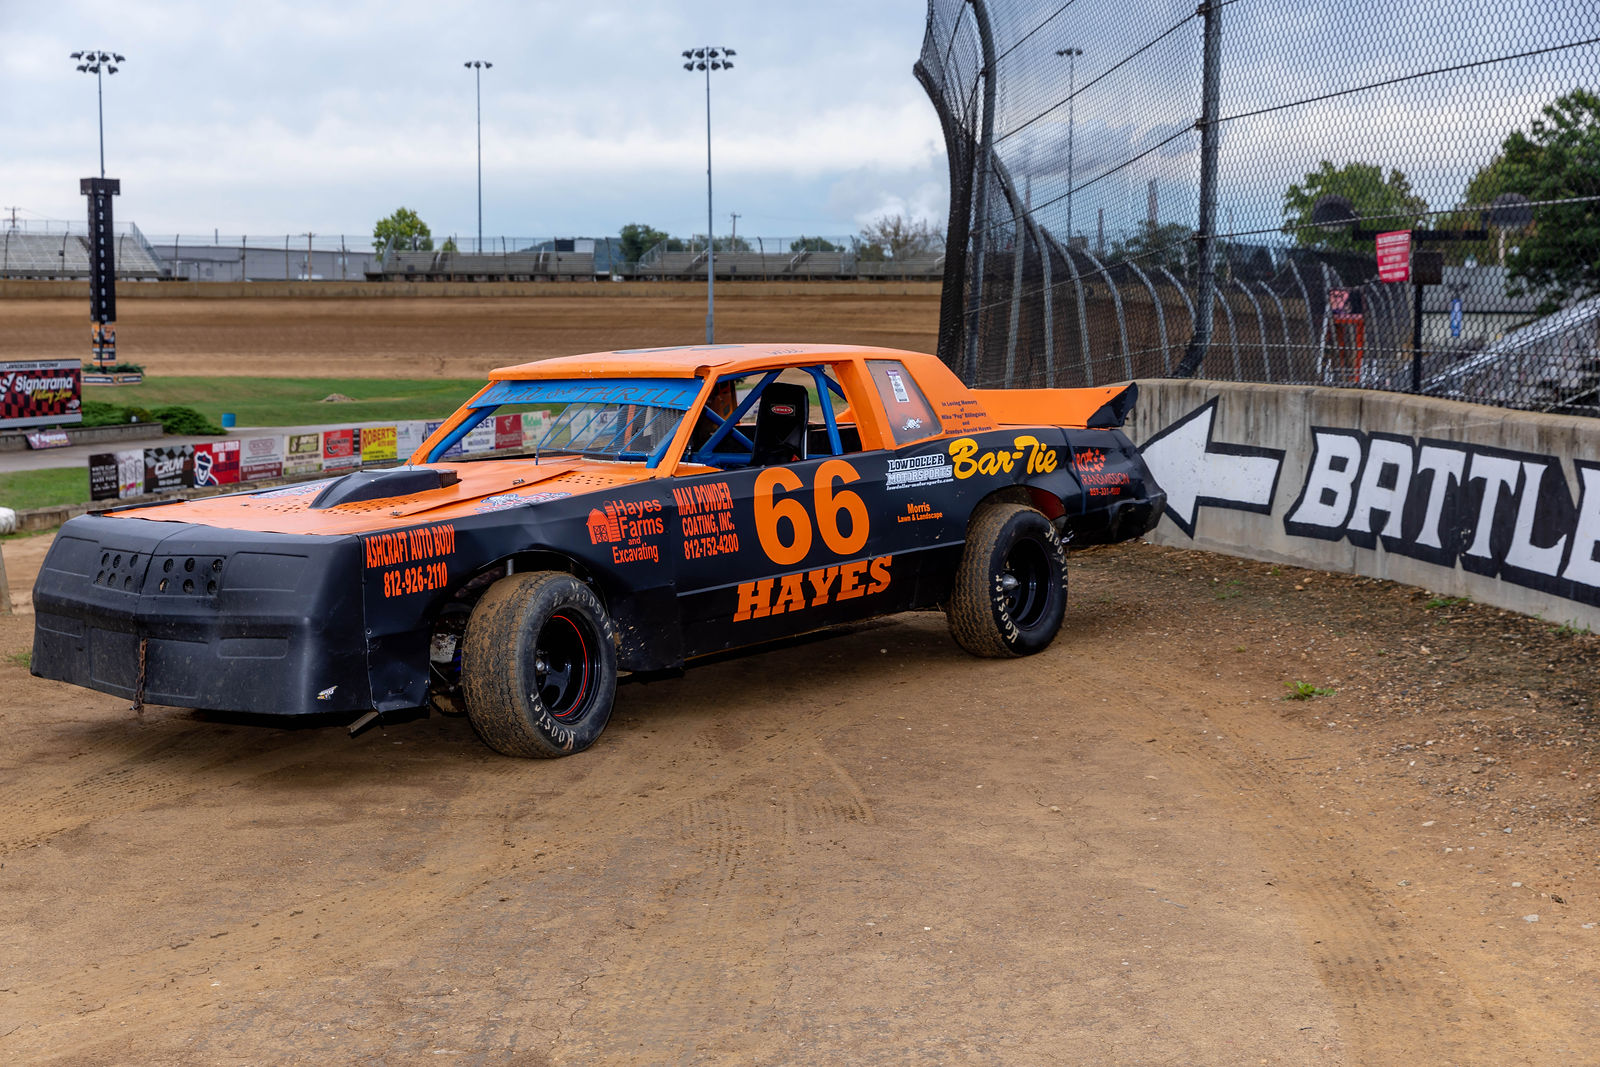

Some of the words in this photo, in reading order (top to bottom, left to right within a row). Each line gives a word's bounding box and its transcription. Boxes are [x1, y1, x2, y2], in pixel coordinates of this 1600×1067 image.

[15, 375, 73, 396] Signarama
[575, 385, 687, 406] THRILL
[362, 427, 397, 450] ROBERT'S
[154, 457, 184, 475] CRUM
[887, 453, 945, 472] LOWDOLLER
[949, 435, 1058, 479] Bar-Tie
[885, 465, 953, 485] MOTORSPORTS
[1081, 472, 1130, 486] RANSMISSION
[612, 499, 663, 518] Hayes
[672, 486, 697, 516] MAX
[693, 482, 734, 514] POWDER
[907, 502, 931, 514] Morris
[753, 459, 870, 565] 66
[897, 514, 911, 523] Lawn
[911, 513, 917, 521] &
[916, 511, 943, 521] Landscape
[618, 517, 664, 539] Farms
[682, 513, 719, 537] COATING,
[718, 511, 735, 531] INC.
[365, 531, 407, 569] ASHCRAFT
[408, 527, 433, 561] AUTO
[434, 524, 456, 556] BODY
[628, 536, 641, 545] and
[684, 533, 739, 560] 812-752-4200
[612, 543, 659, 564] Excavating
[384, 562, 448, 598] 812-926-2110
[733, 555, 893, 623] HAYES
